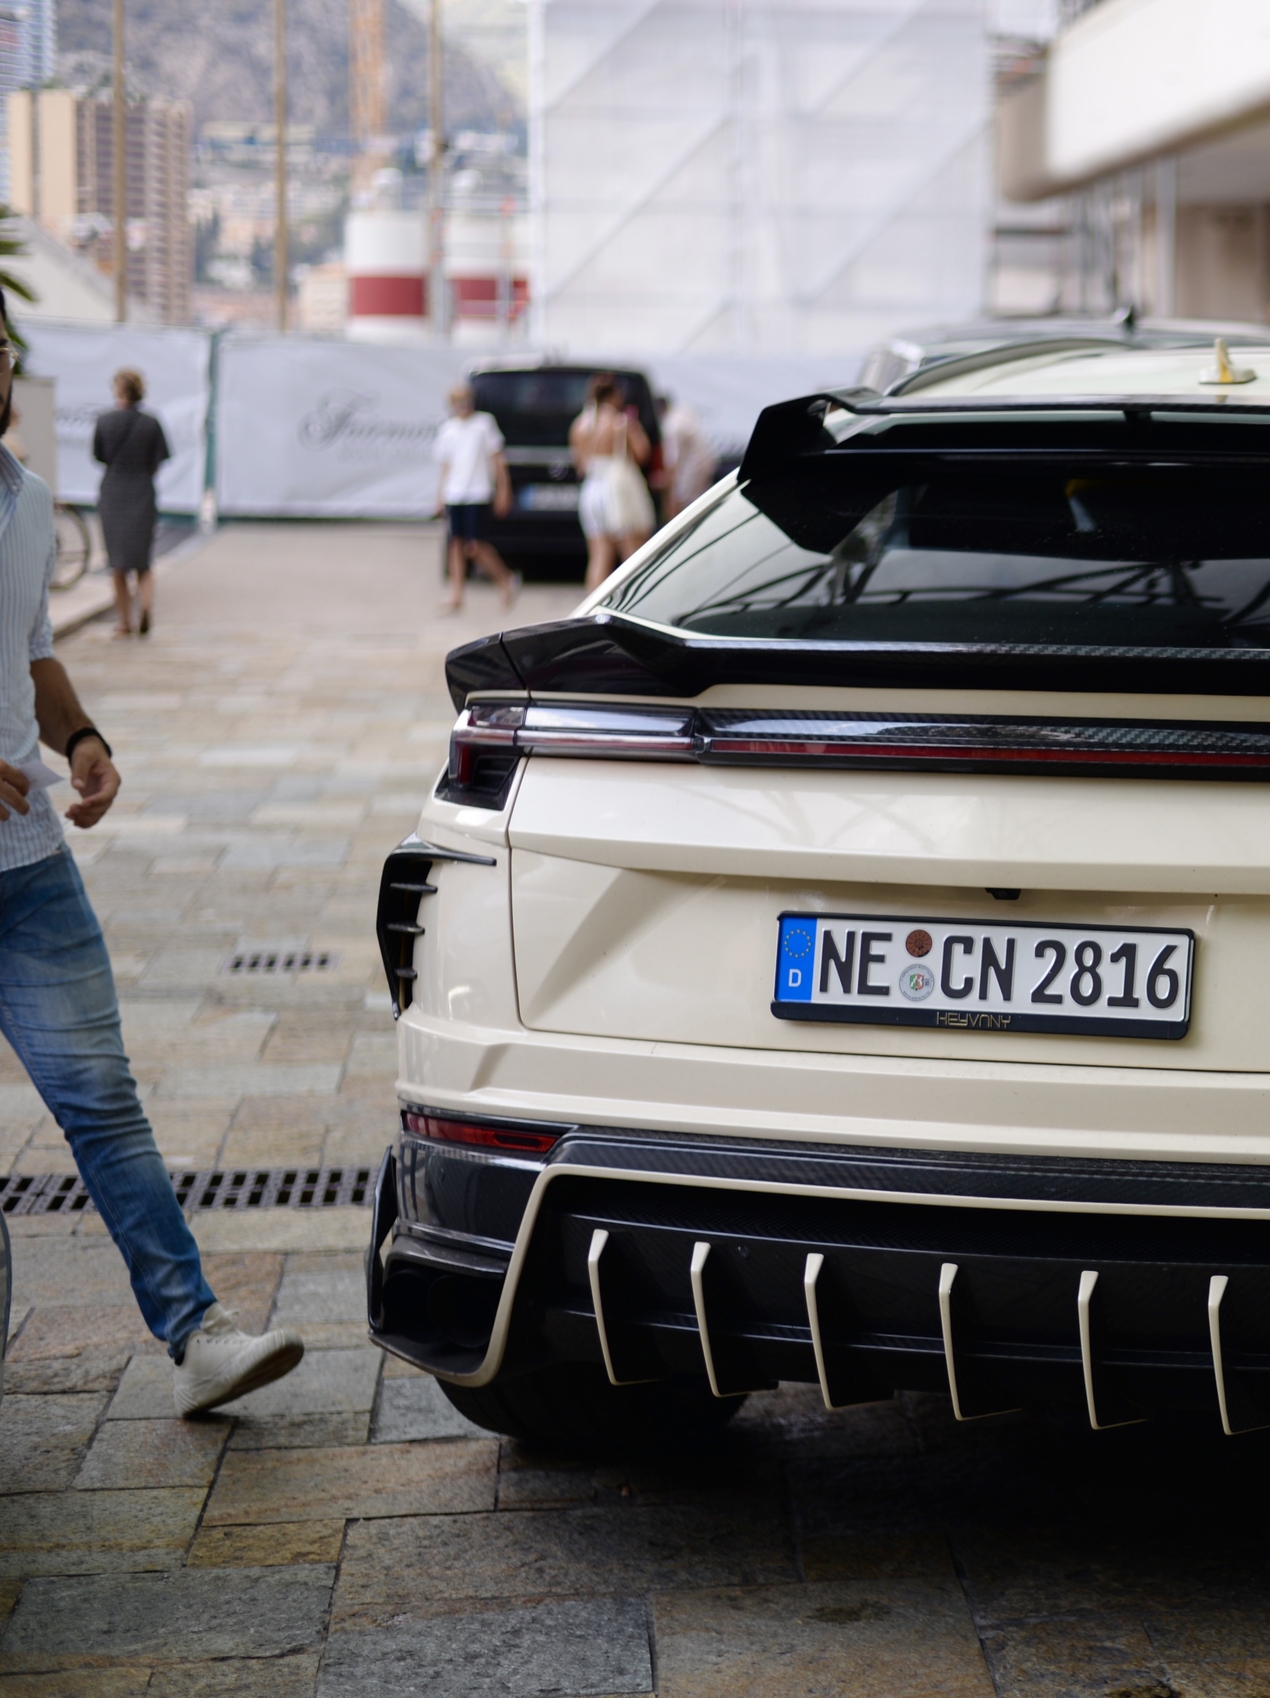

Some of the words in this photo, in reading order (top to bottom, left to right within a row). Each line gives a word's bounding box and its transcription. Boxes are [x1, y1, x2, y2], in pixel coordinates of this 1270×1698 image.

[788, 968, 802, 987] D
[819, 929, 893, 996] NE
[941, 935, 1016, 1002] CN
[1031, 939, 1180, 1009] 2816
